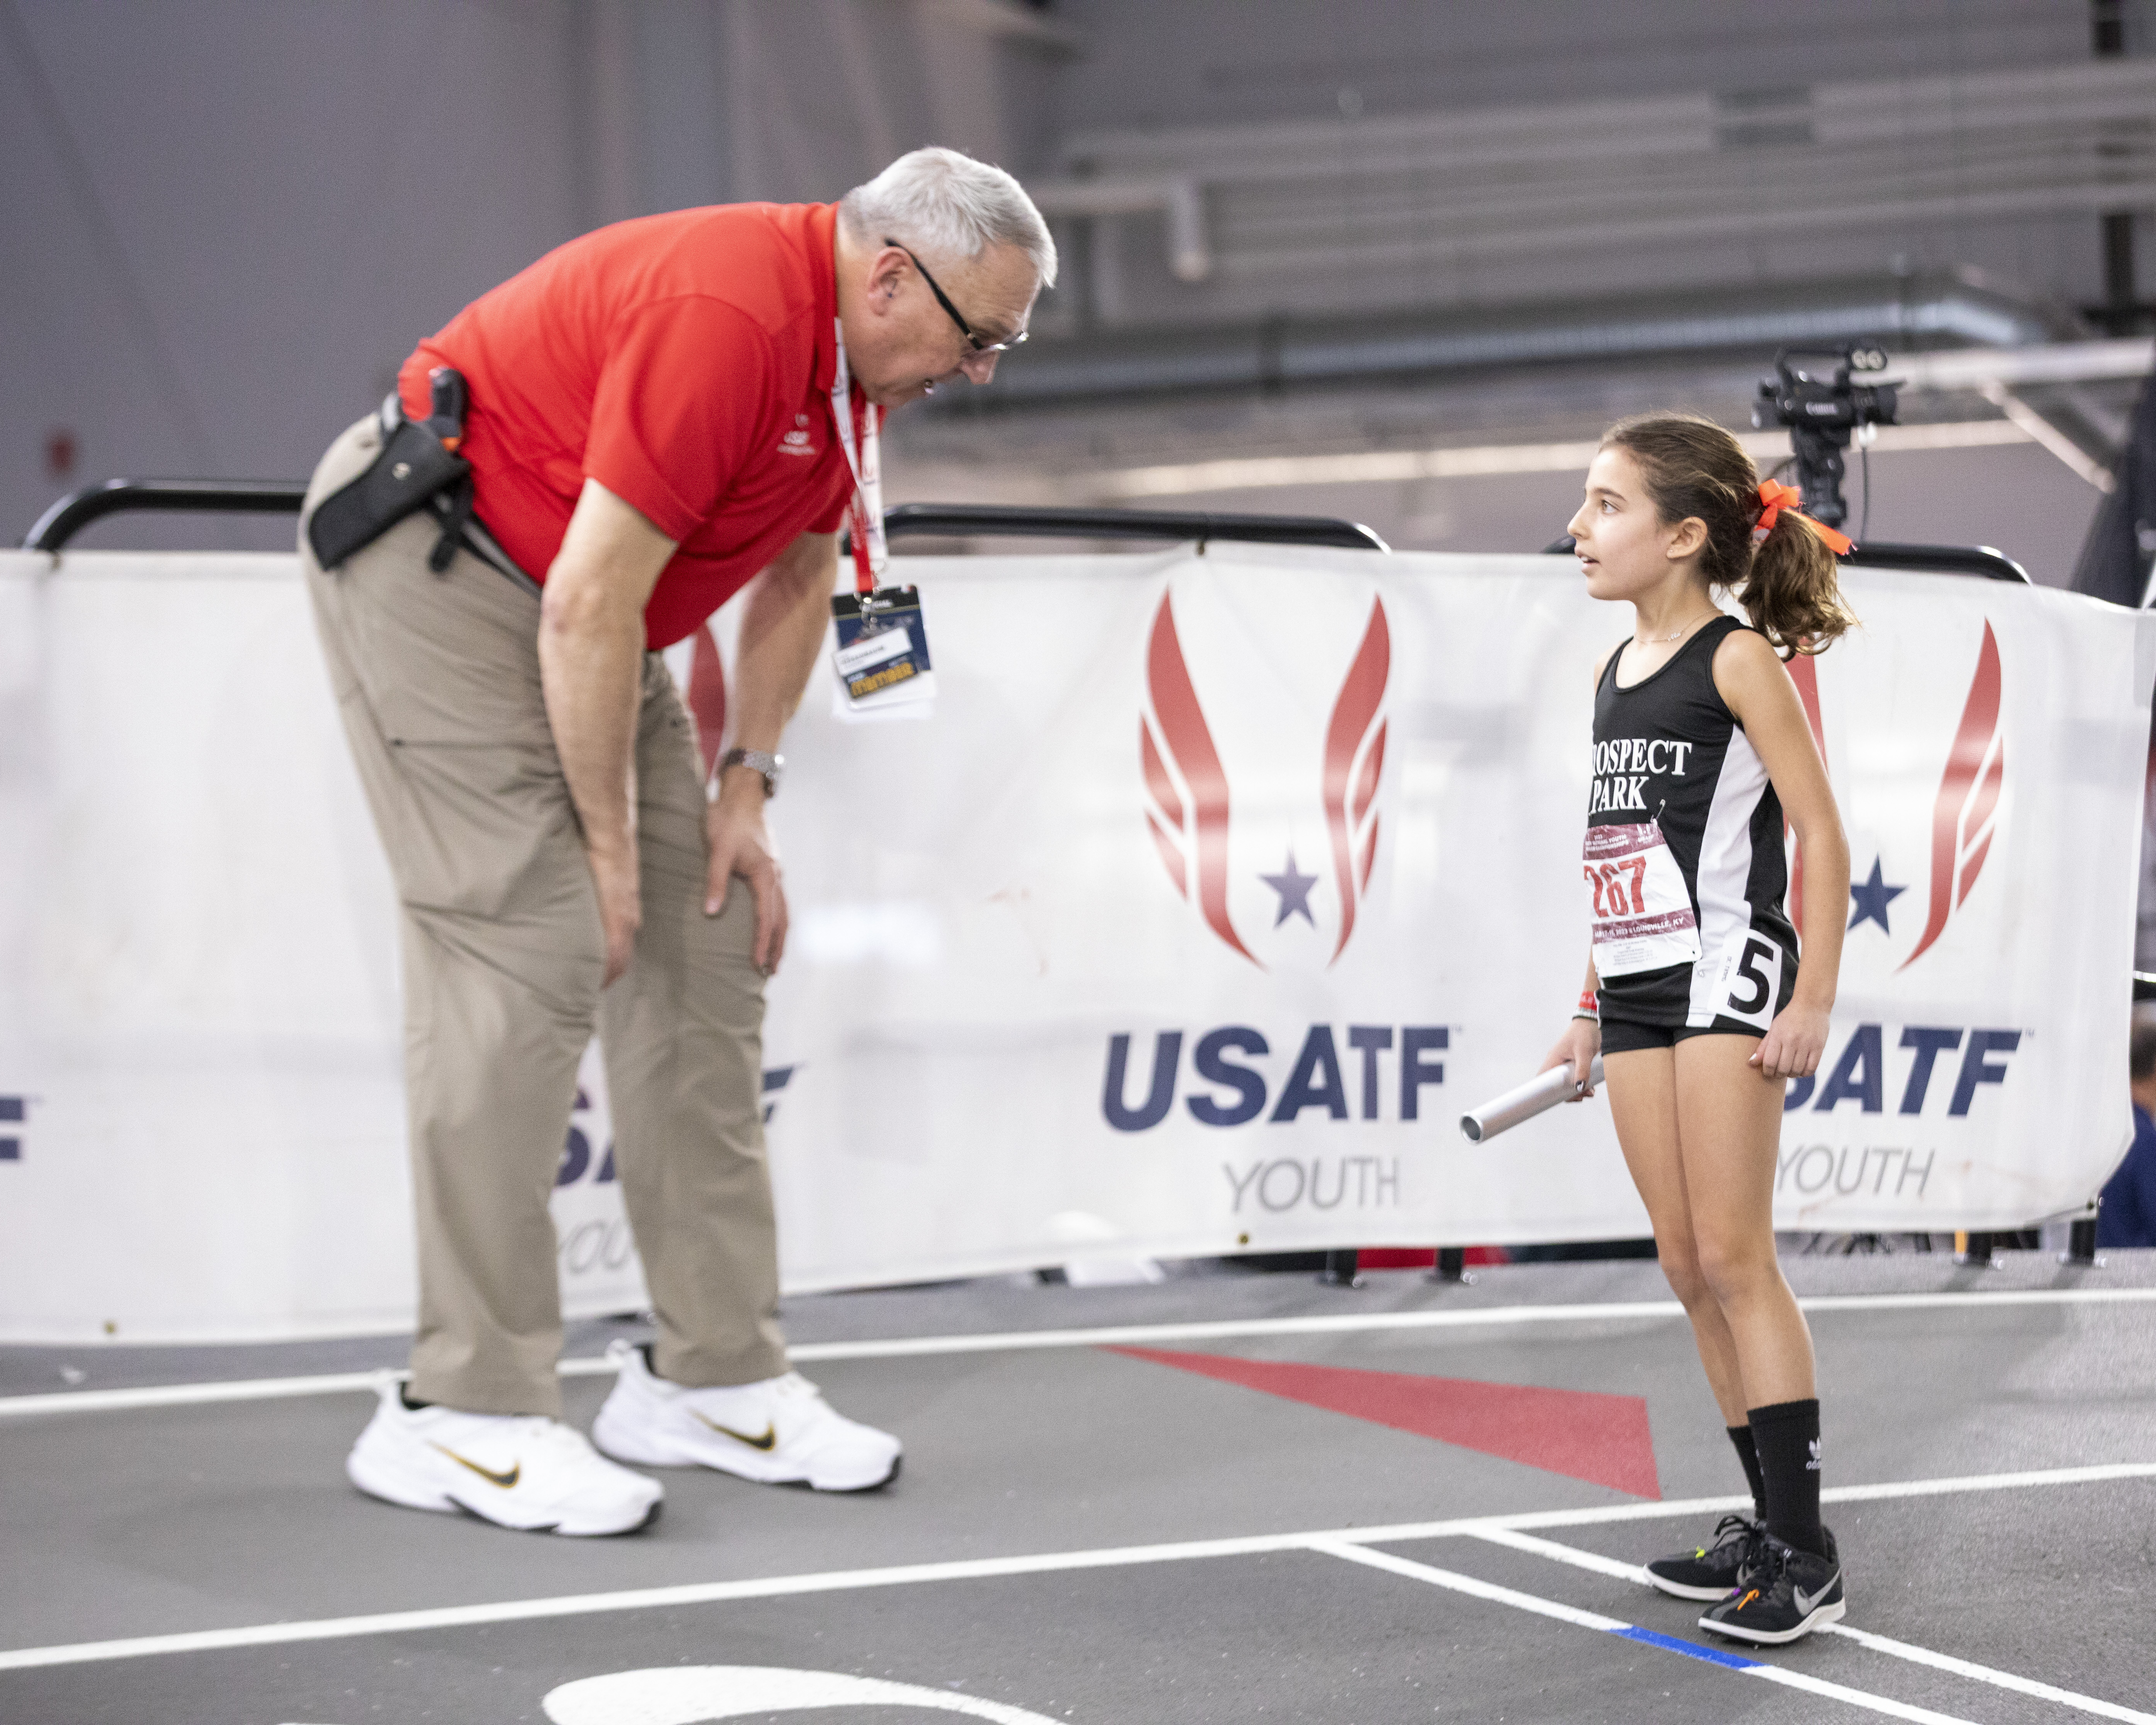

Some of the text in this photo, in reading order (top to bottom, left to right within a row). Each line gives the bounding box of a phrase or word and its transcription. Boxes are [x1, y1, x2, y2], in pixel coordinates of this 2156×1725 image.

[1593, 739, 1692, 775] OSPECT
[1592, 776, 1649, 813] PARK
[1609, 834, 1627, 843] YOUTH
[1584, 855, 1647, 918] 267
[1633, 921, 1671, 933] LOUISVILLE,
[1673, 917, 1684, 925] KY
[1727, 937, 1774, 1014] 5
[1100, 1023, 1450, 1134] USATF
[1783, 1023, 2022, 1119] ATF
[1221, 1156, 1401, 1214] YOUTH
[1776, 1143, 1936, 1196] YOUTH
